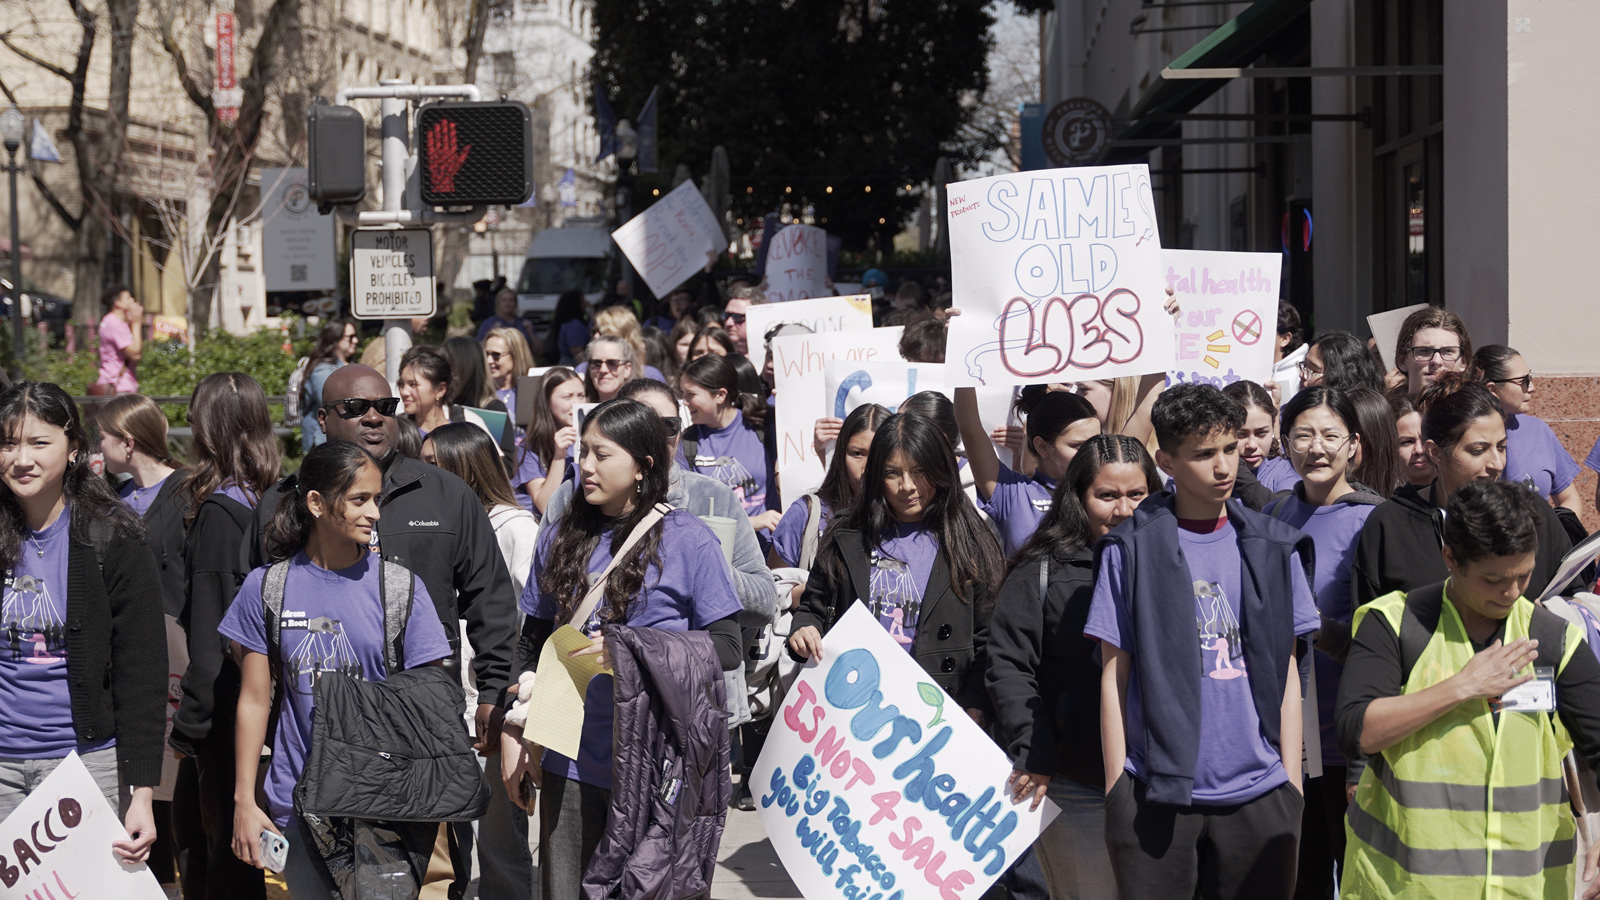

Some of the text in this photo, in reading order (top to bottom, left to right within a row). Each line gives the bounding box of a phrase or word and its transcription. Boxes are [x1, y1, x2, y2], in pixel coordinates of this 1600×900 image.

[950, 195, 966, 206] NEW
[951, 201, 980, 218] PRODUCTS
[982, 172, 1136, 242] SAME
[375, 236, 408, 250] MOTOR
[366, 291, 422, 305] PROHIBITED
[784, 268, 814, 282] THE
[1015, 244, 1118, 298] OLD
[1201, 267, 1272, 295] health
[1000, 288, 1144, 378] LIES
[784, 680, 976, 900] IS NOT 4 SALE
[892, 726, 1018, 876] health
[0, 797, 82, 889] BACCO
[793, 753, 896, 891] Big Tobacco
